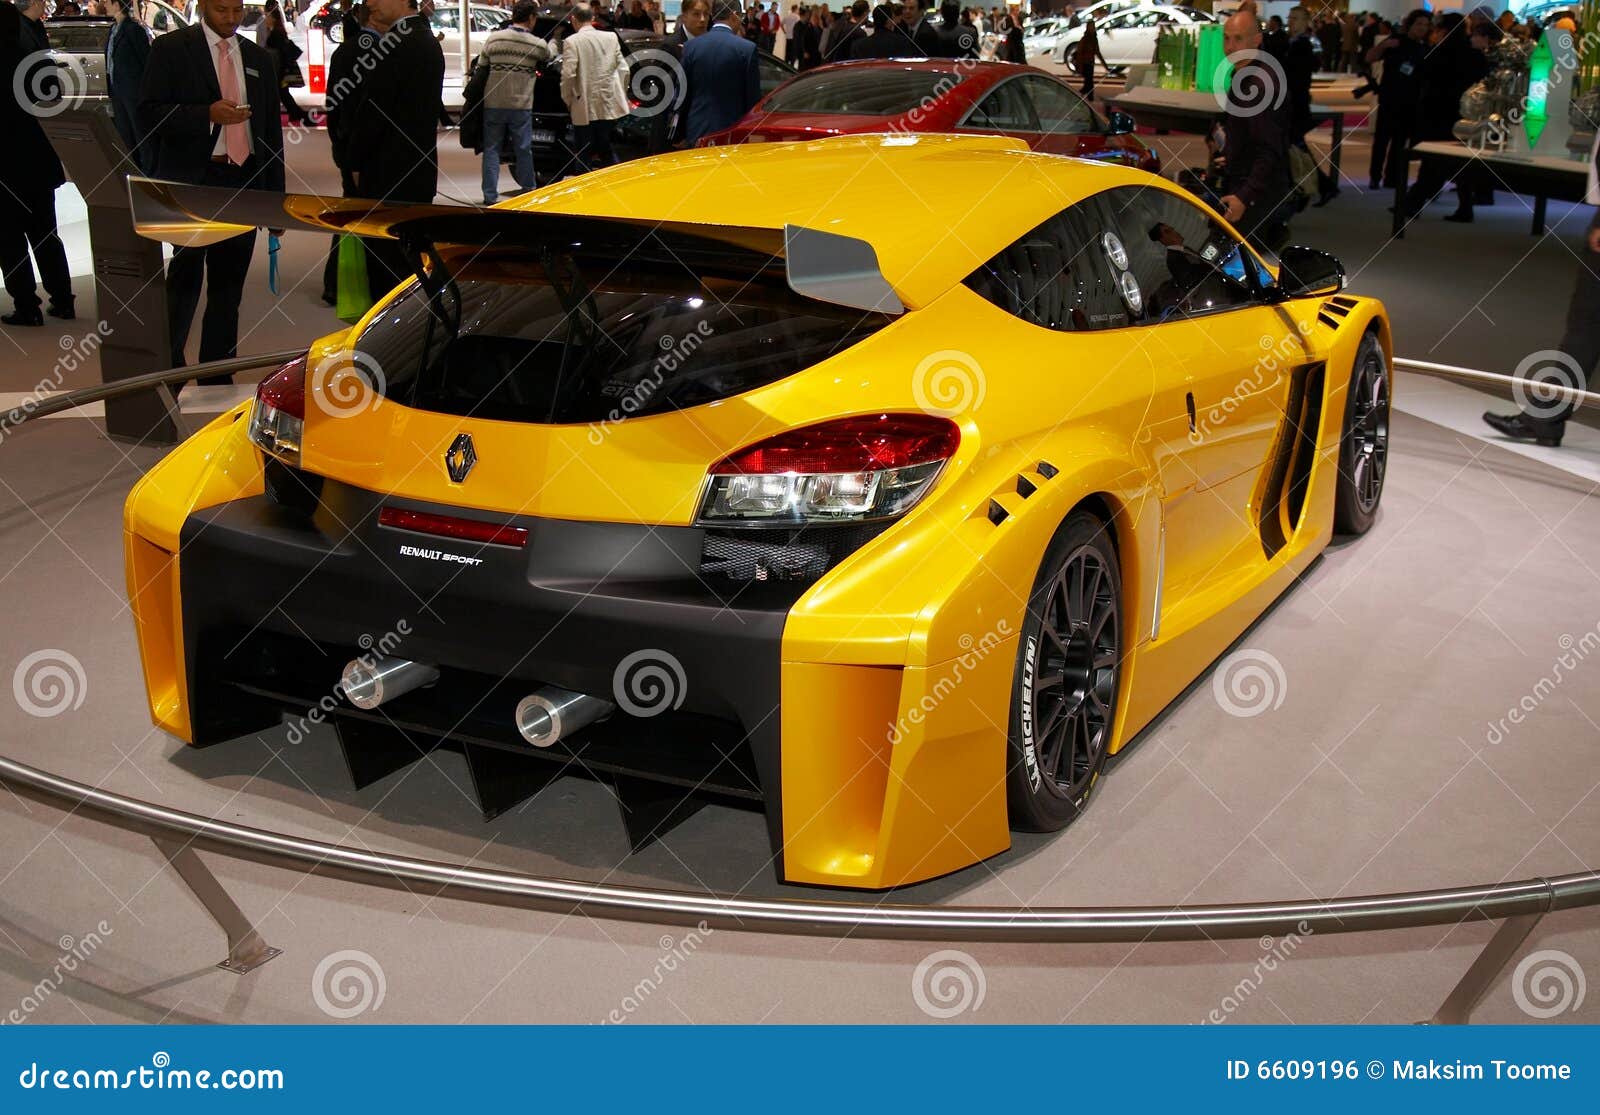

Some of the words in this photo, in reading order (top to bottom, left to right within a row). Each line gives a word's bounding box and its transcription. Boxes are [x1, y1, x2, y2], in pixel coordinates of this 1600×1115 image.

[400, 545, 442, 560] RENAULT
[442, 553, 483, 566] SPORT
[1023, 640, 1037, 767] MICHELIN
